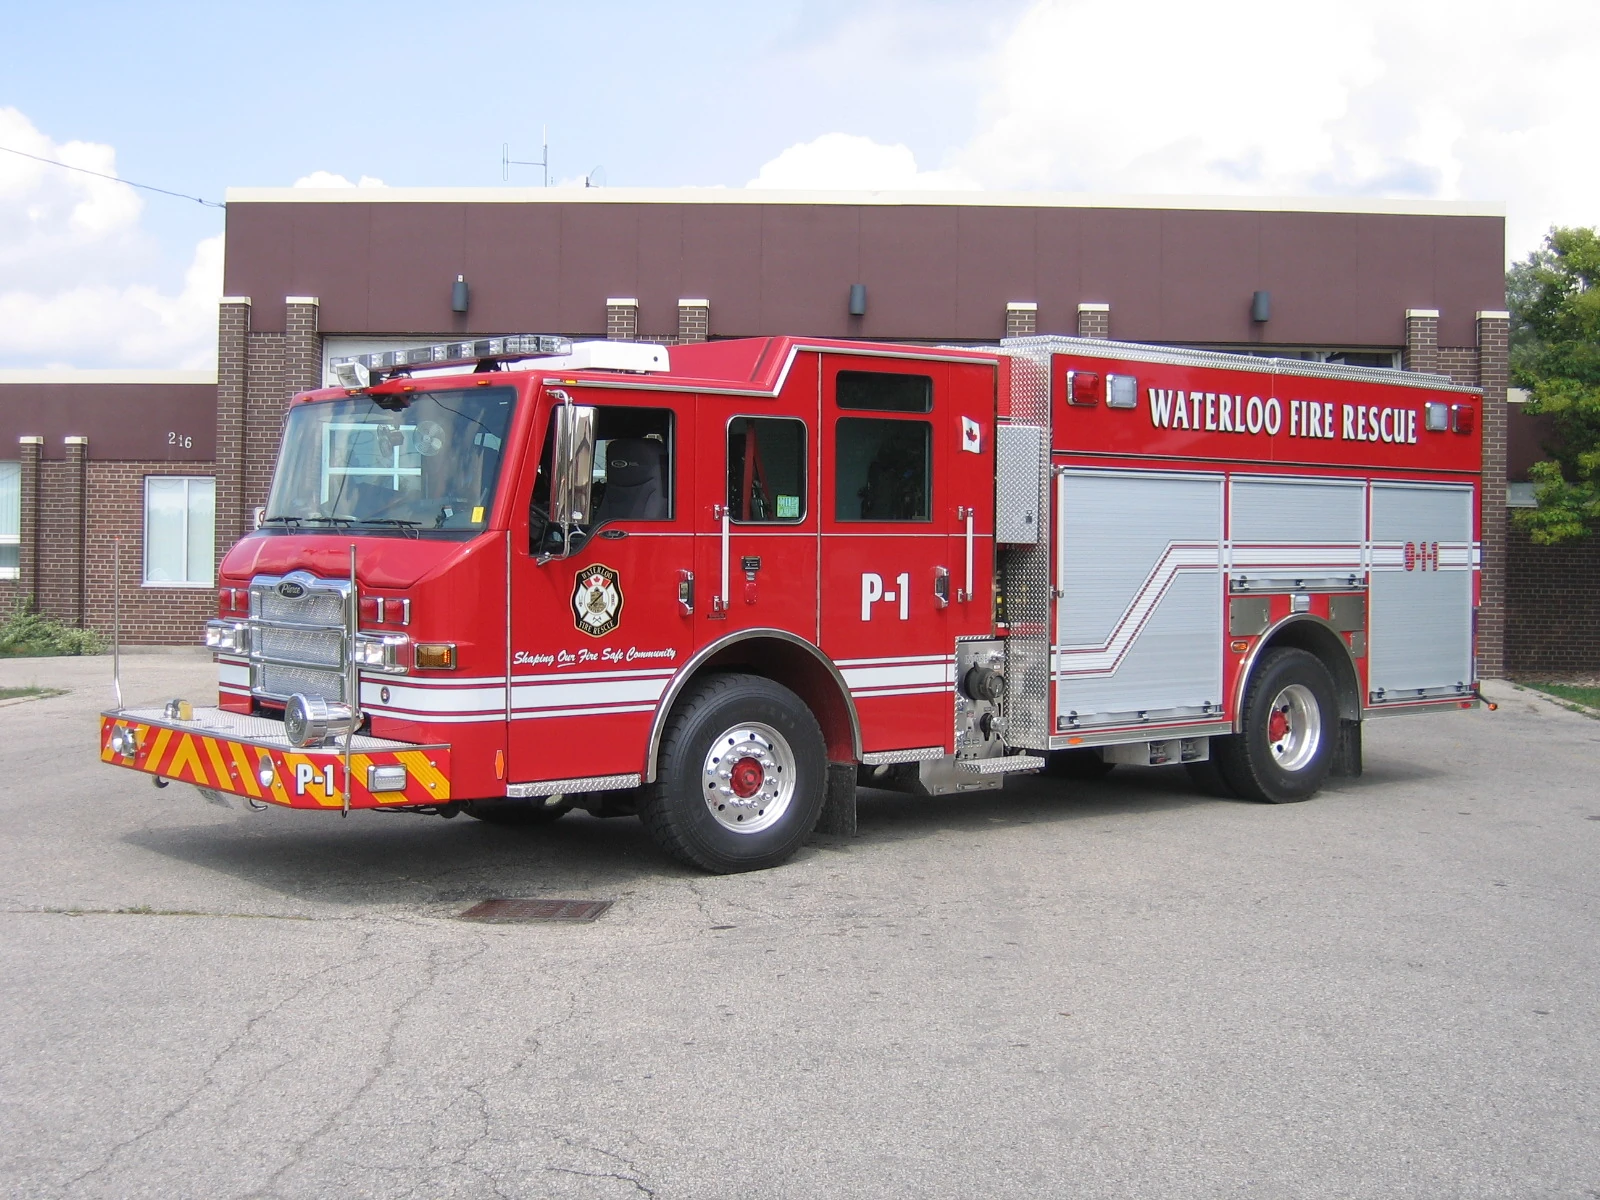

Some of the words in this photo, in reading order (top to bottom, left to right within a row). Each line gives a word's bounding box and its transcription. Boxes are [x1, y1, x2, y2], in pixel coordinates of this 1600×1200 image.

[1148, 388, 1282, 436] WATERLOO
[1289, 400, 1335, 439] FIRE
[1342, 404, 1418, 445] RESCUE
[168, 431, 192, 449] 216
[581, 566, 613, 580] WATERLOO
[861, 572, 909, 621] P-1
[578, 620, 593, 633] FIRE
[513, 651, 554, 666] Shaping
[557, 649, 576, 667] Our
[578, 648, 599, 664] Fire
[601, 647, 624, 664] Safe
[625, 646, 677, 662] Community
[296, 763, 335, 797] P-1
